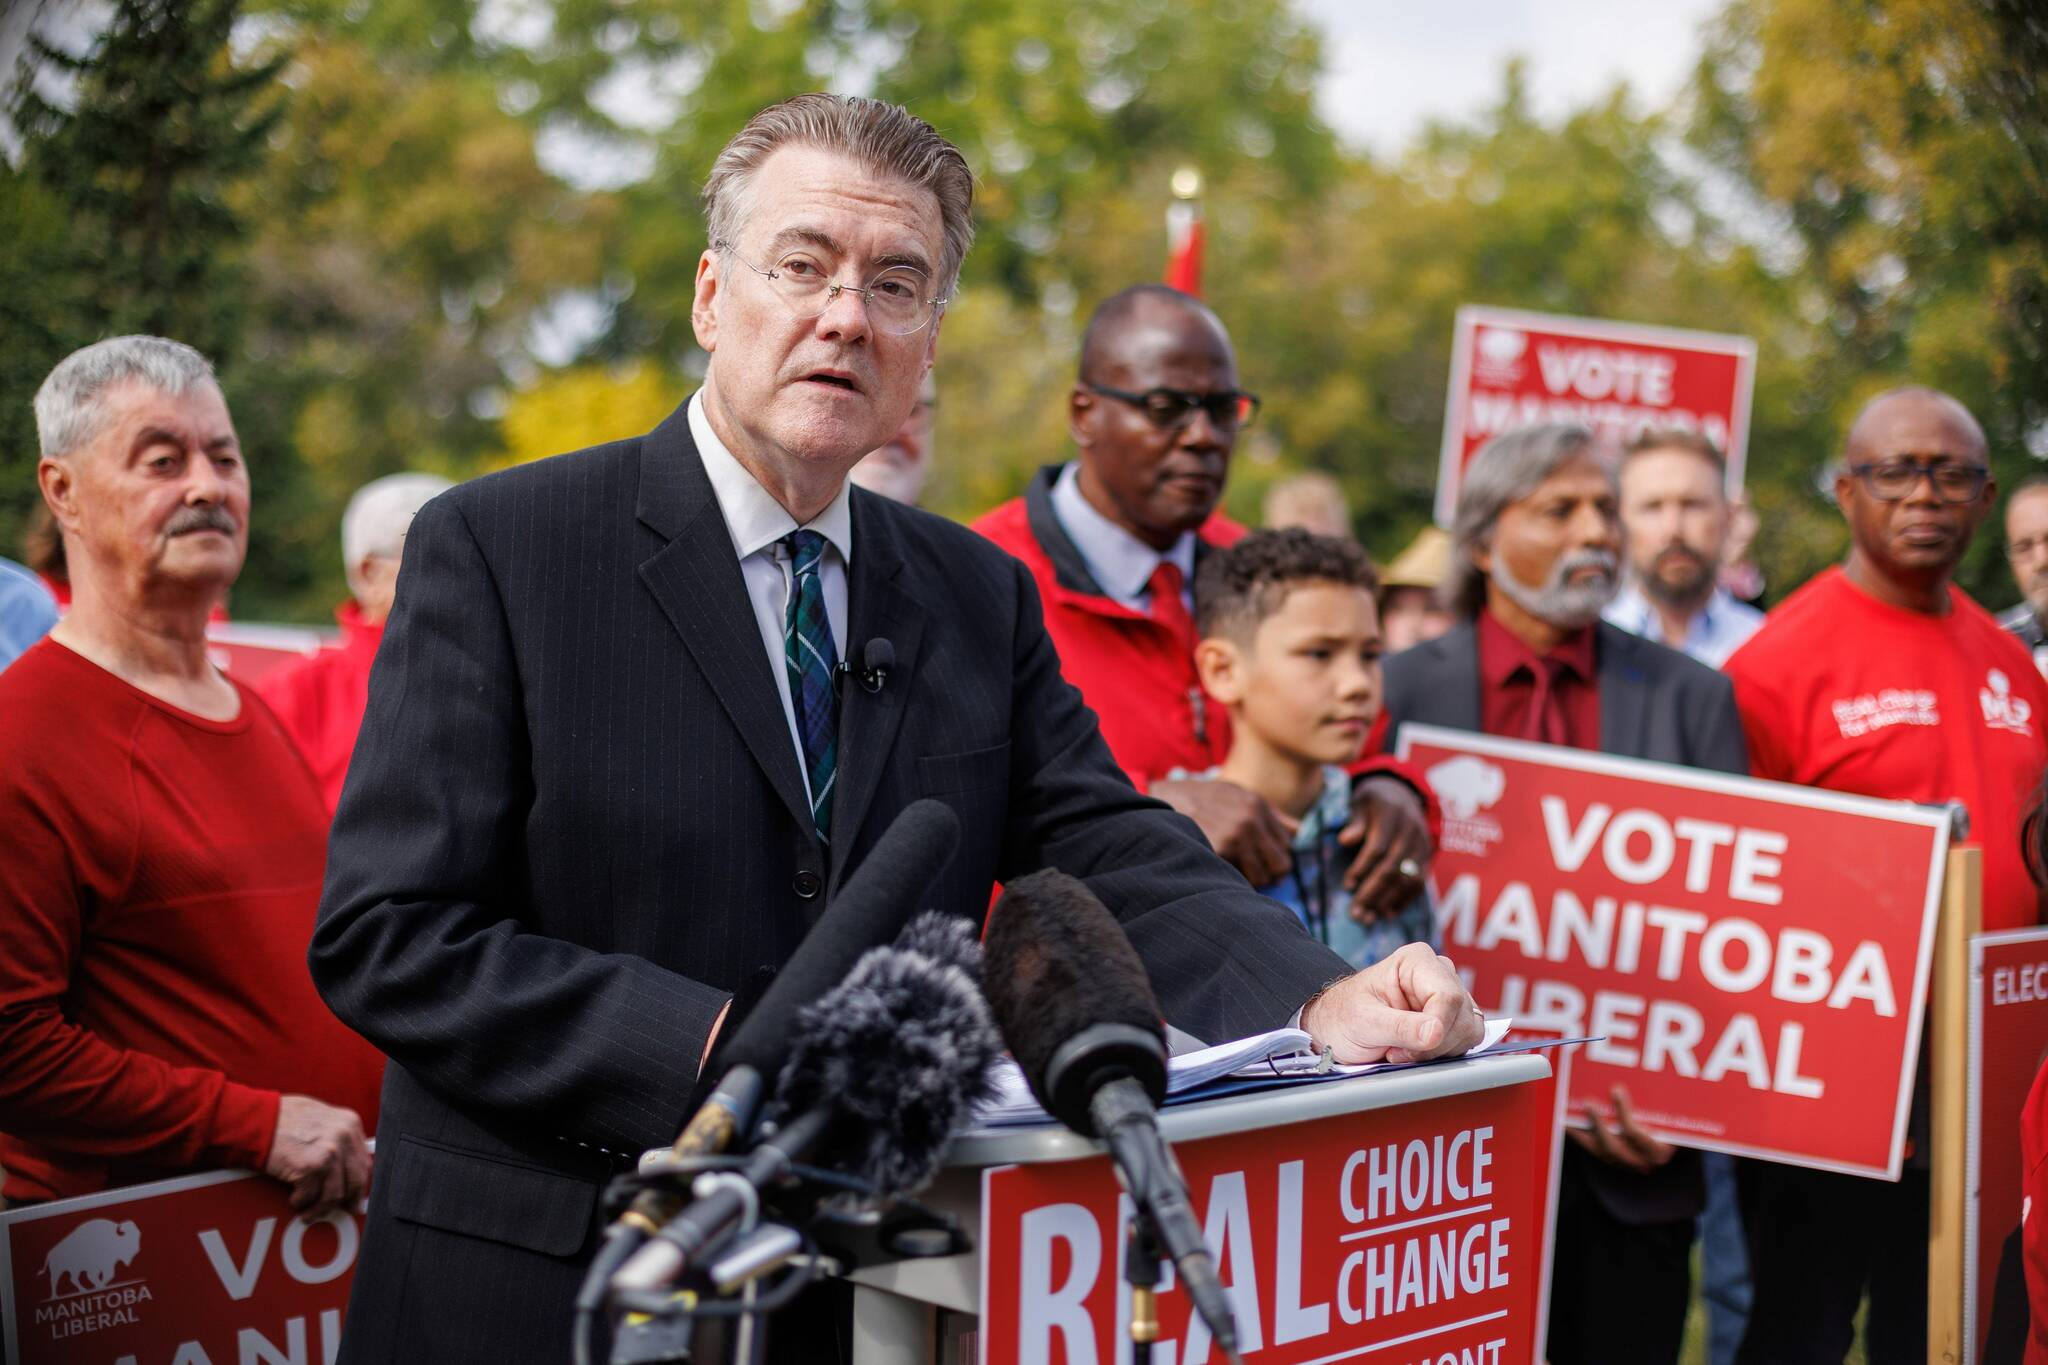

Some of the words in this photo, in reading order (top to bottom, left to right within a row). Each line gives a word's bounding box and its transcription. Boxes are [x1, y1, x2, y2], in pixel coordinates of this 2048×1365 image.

[1536, 343, 1676, 406] VOTE
[1540, 794, 1790, 906] VOTE
[1993, 962, 2048, 1006] ELEC
[1340, 1126, 1494, 1225] CHOICE
[198, 1199, 368, 1301] VO
[1337, 1218, 1511, 1326] CHANGE
[35, 1285, 152, 1325] MANITOBA
[52, 1307, 139, 1340] LIBERAL
